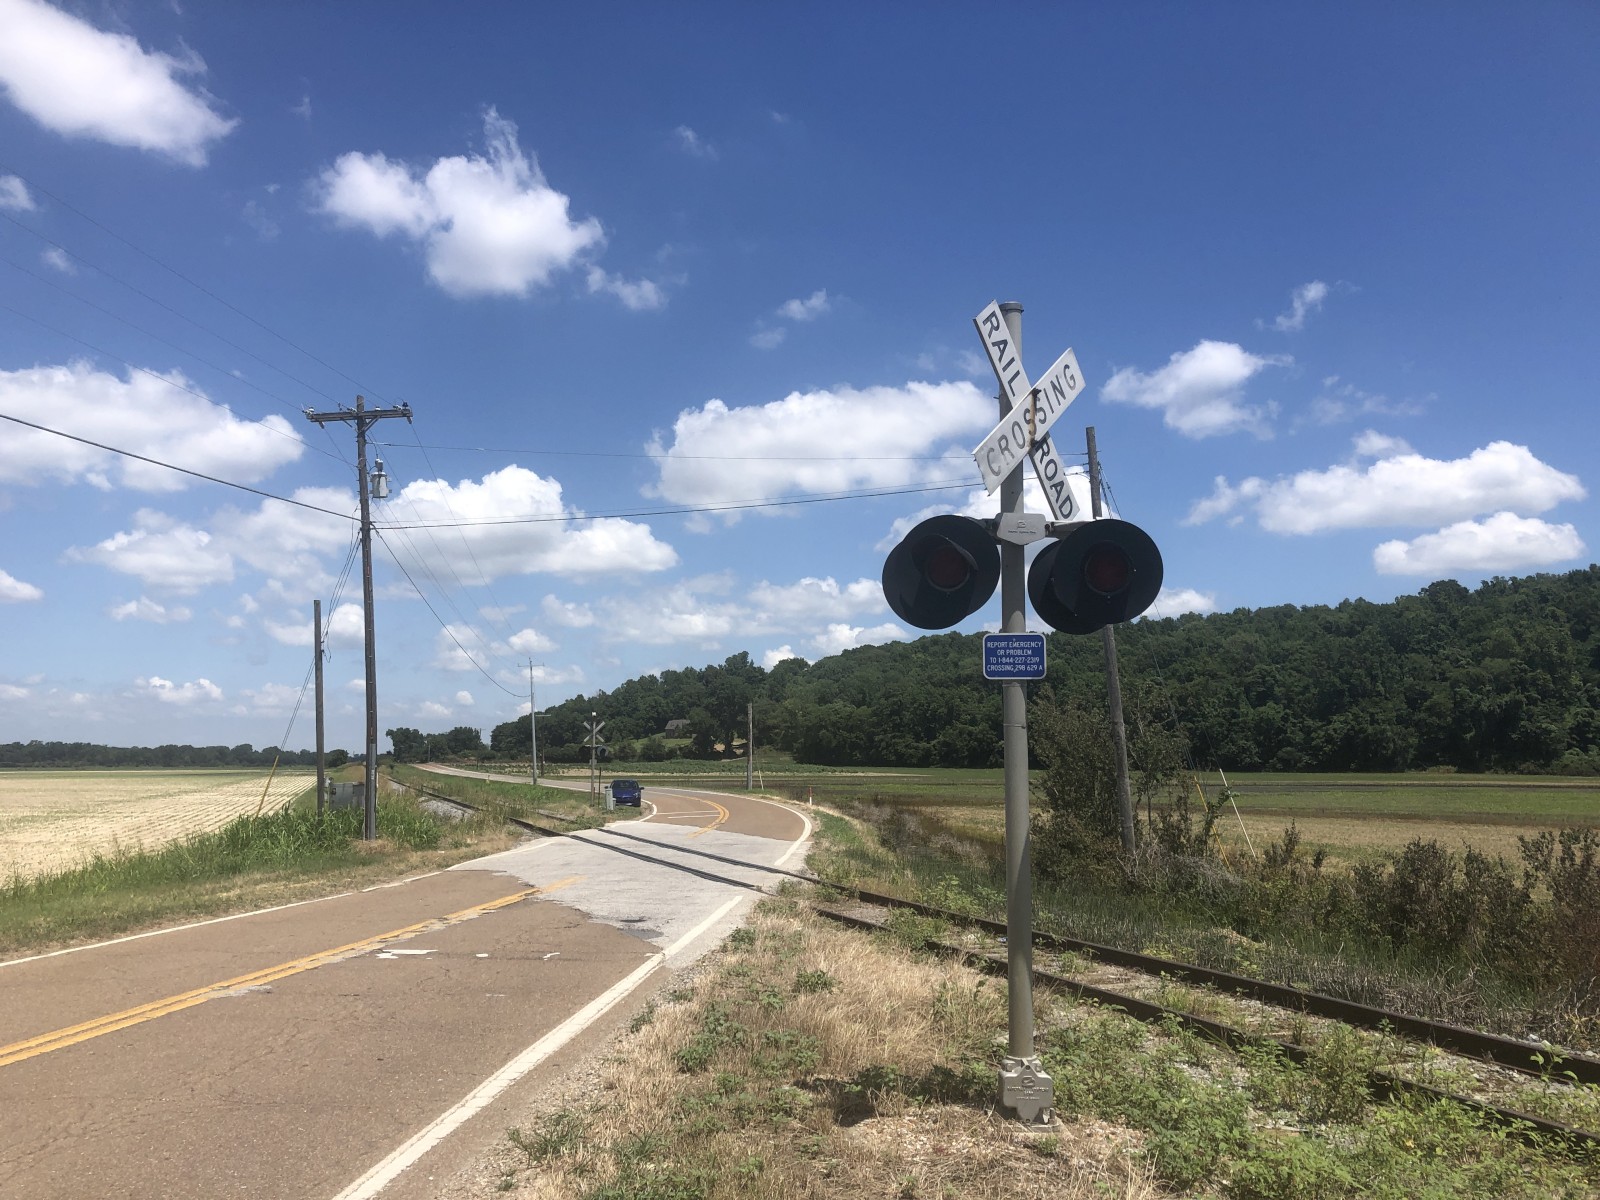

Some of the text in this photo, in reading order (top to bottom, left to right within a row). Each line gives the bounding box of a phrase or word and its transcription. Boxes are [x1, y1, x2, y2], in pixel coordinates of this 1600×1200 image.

[983, 311, 1073, 520] RAIL ROAD
[986, 364, 1077, 477] CROSSING
